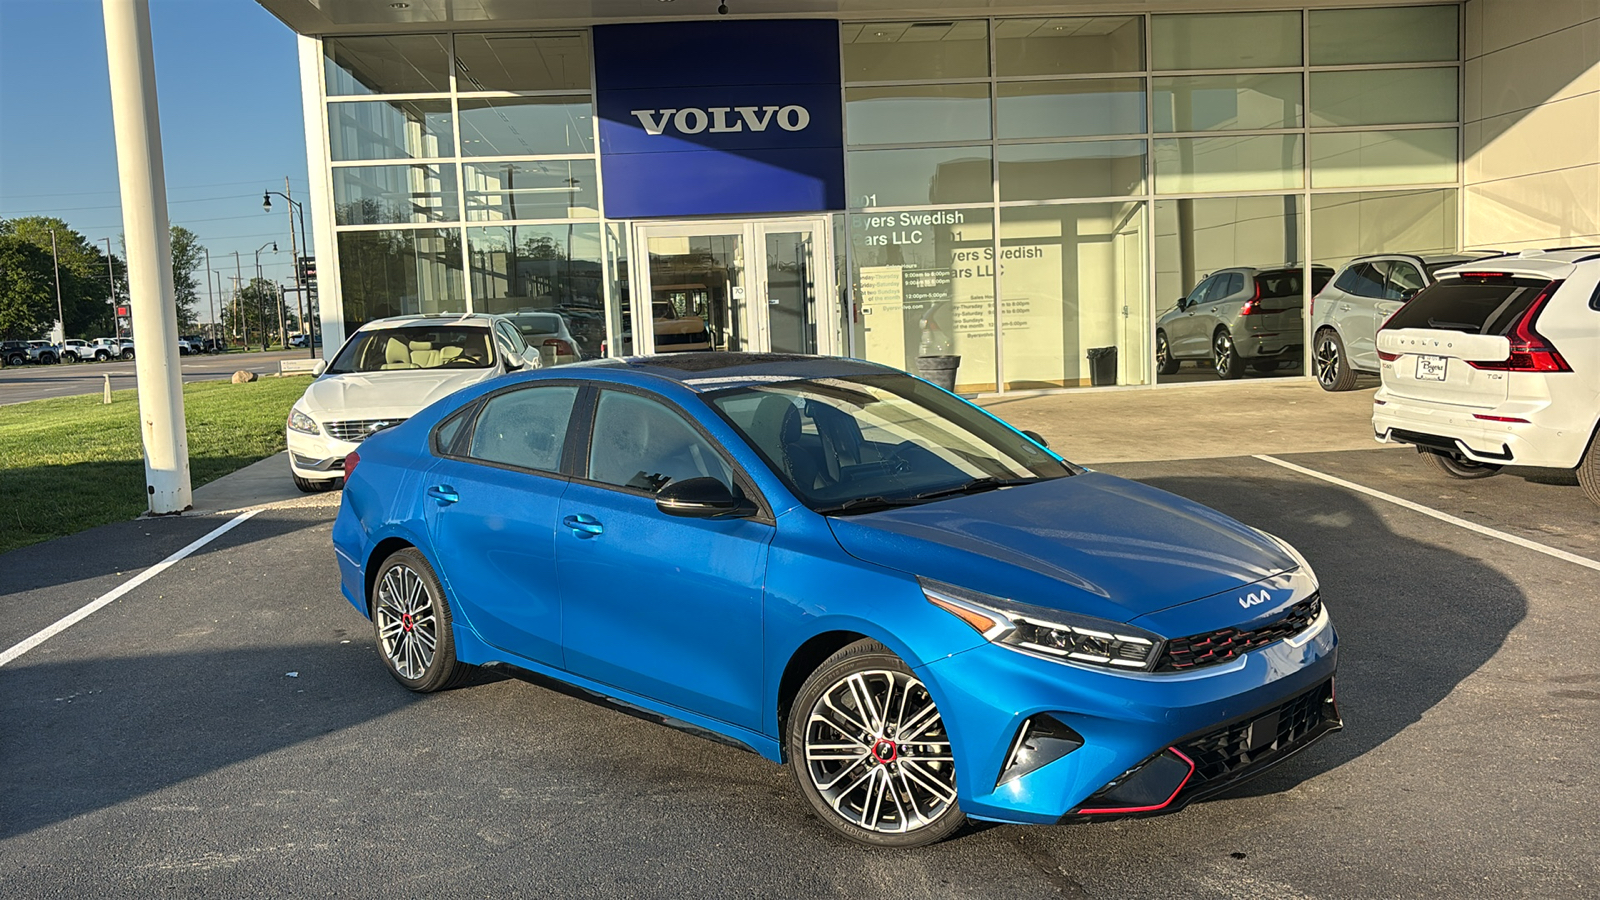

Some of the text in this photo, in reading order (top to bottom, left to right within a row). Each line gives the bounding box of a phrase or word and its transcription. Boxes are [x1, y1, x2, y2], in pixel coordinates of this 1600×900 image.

[630, 105, 810, 135] VOLVO
[900, 211, 964, 226] Swedish
[892, 230, 923, 245] LLC
[951, 250, 979, 264] yers
[951, 268, 972, 278] ars
[1400, 339, 1453, 348] VOLVO
